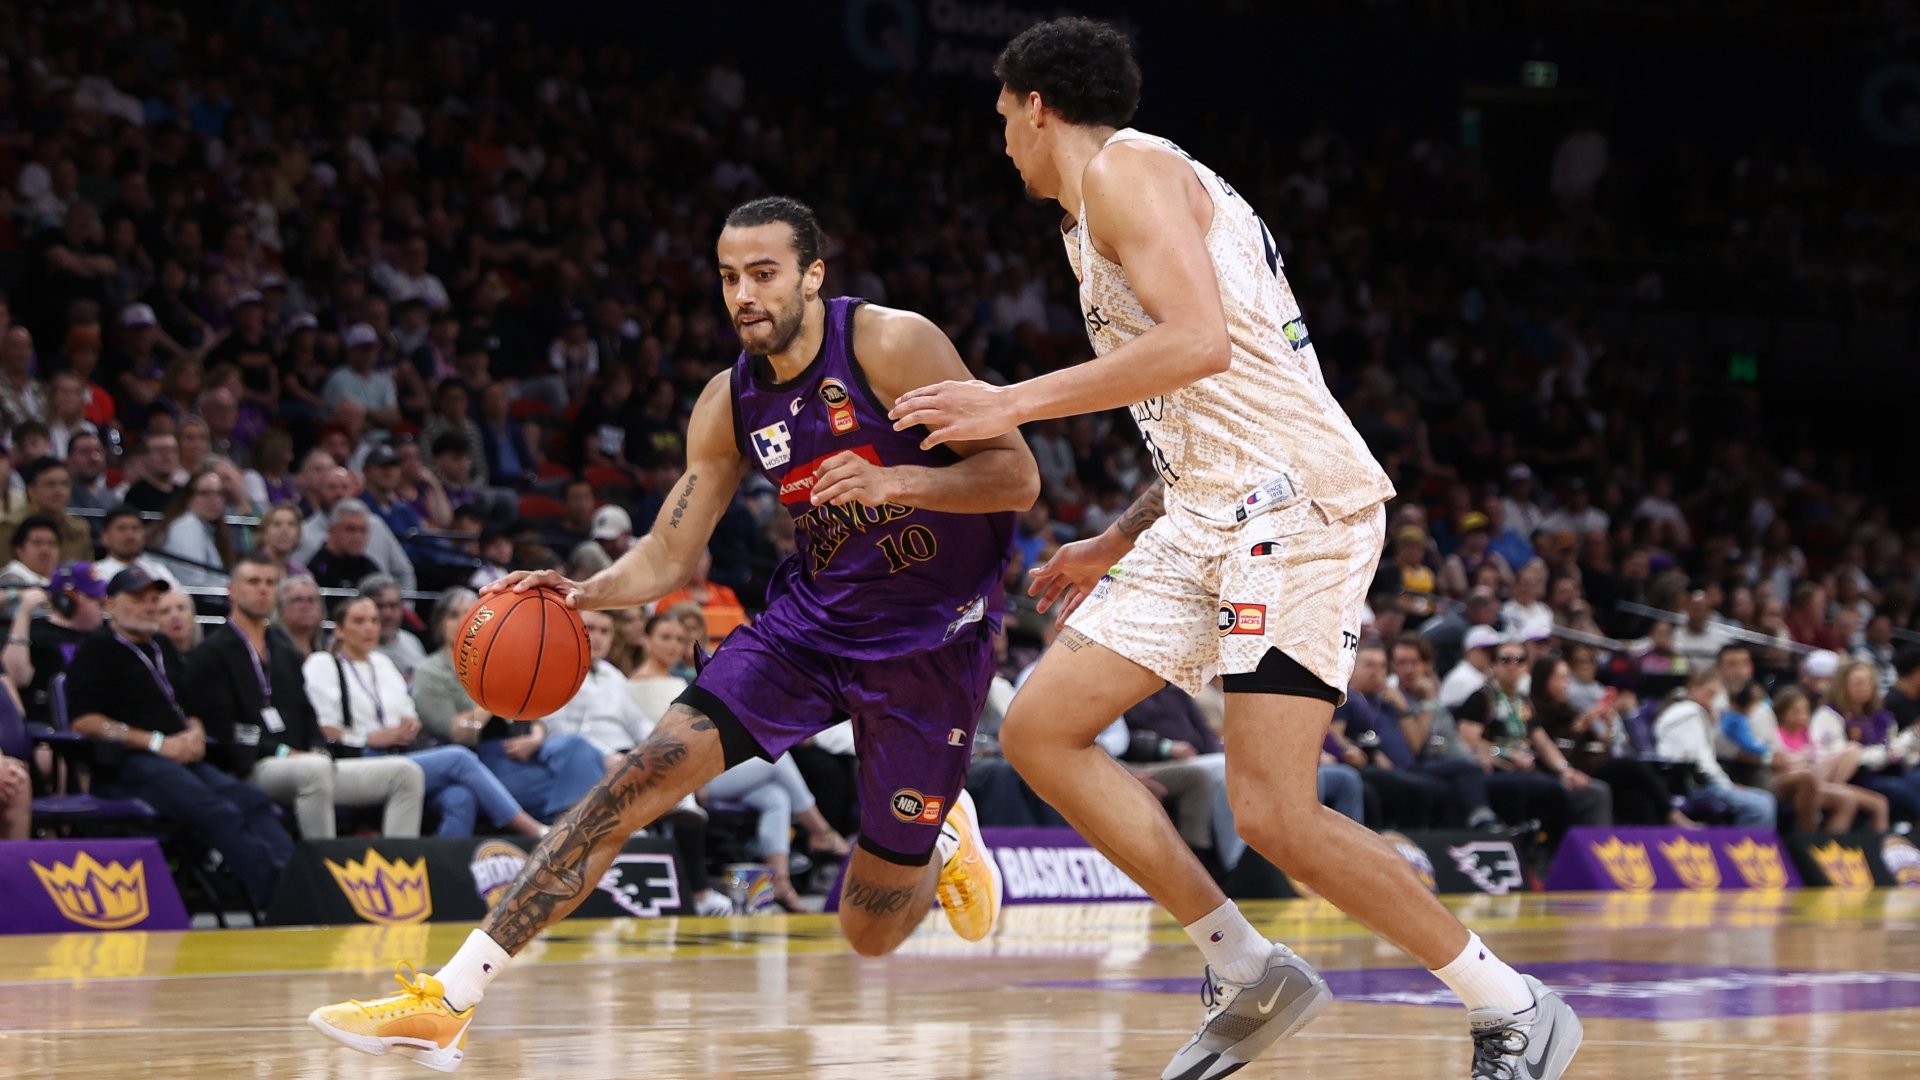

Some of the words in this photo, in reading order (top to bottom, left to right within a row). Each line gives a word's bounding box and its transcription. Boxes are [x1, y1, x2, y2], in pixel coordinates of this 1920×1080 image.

[876, 524, 937, 574] 10
[897, 796, 919, 815] NBL
[997, 847, 1150, 899] BASKETBA
